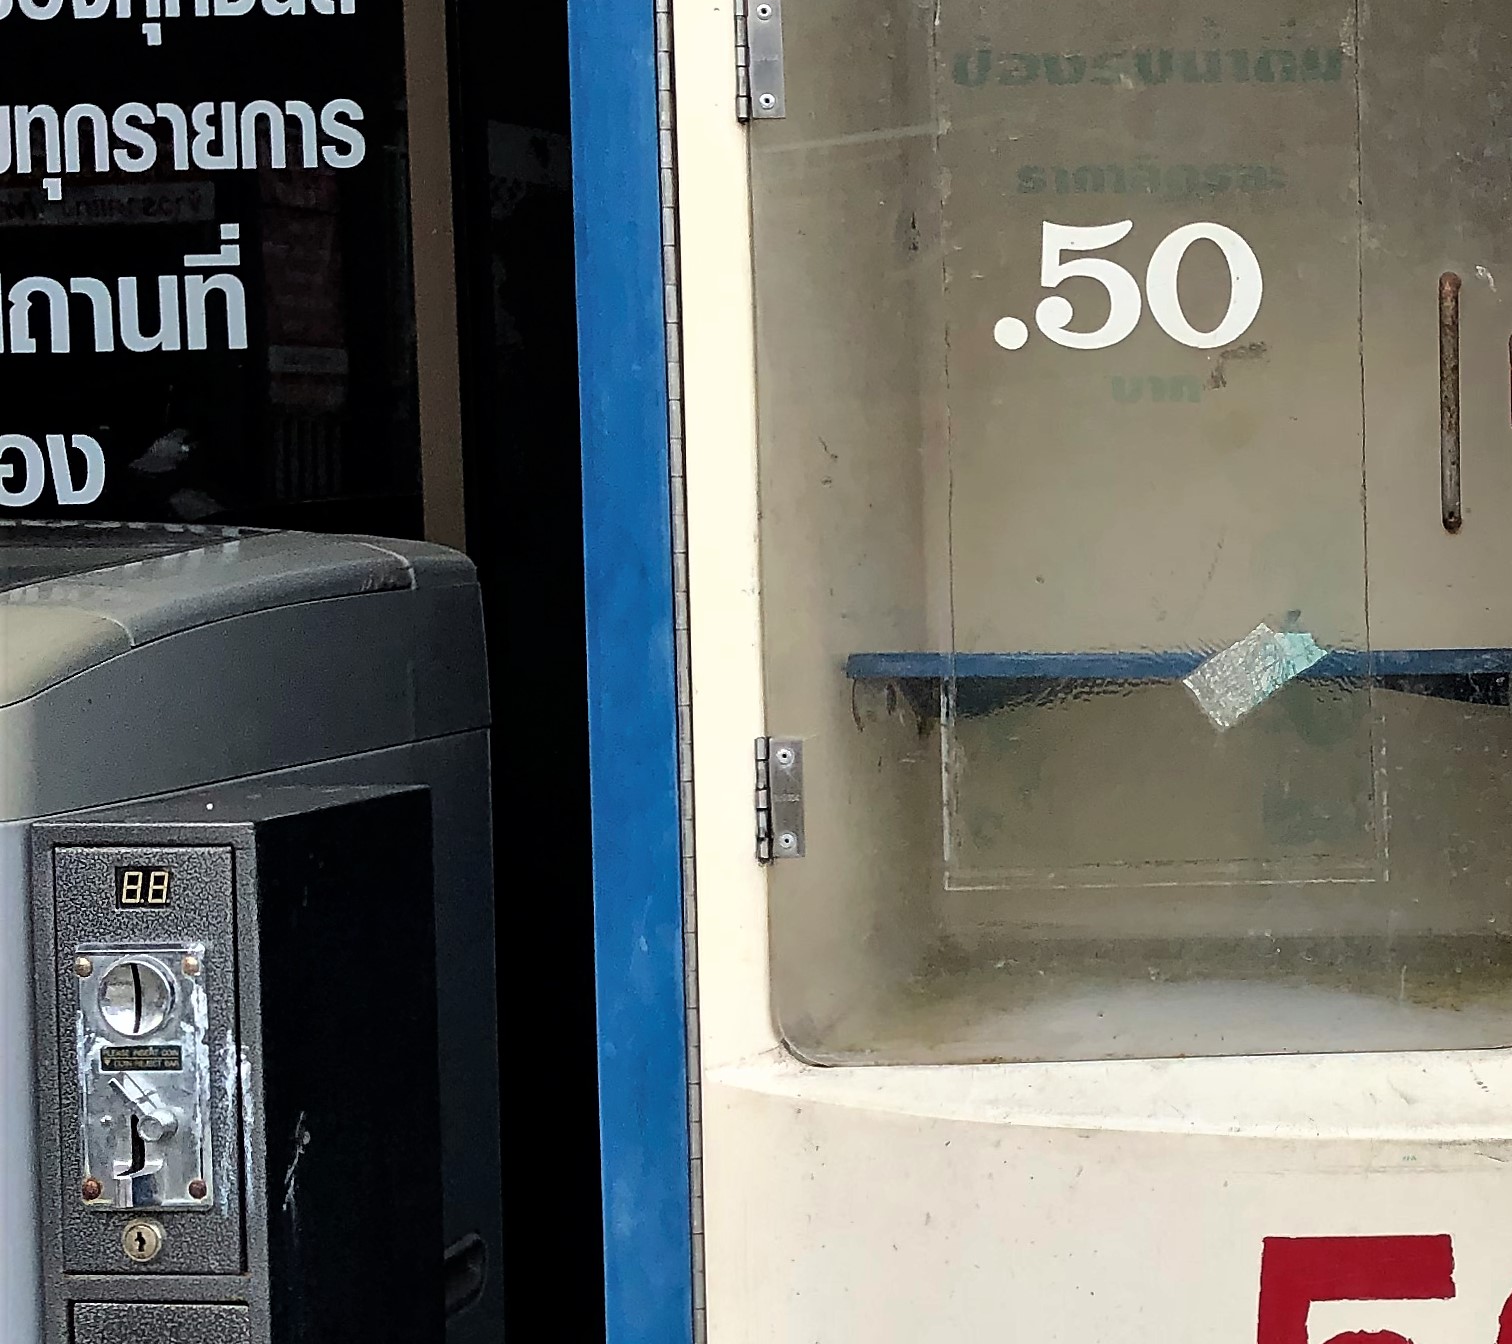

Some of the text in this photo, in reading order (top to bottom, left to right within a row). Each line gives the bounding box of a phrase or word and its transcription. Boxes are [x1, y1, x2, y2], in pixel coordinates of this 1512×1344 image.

[0, 99, 365, 200] ทุกรายการ
[0, 223, 247, 353] ถานที่
[994, 220, 1263, 349] .50
